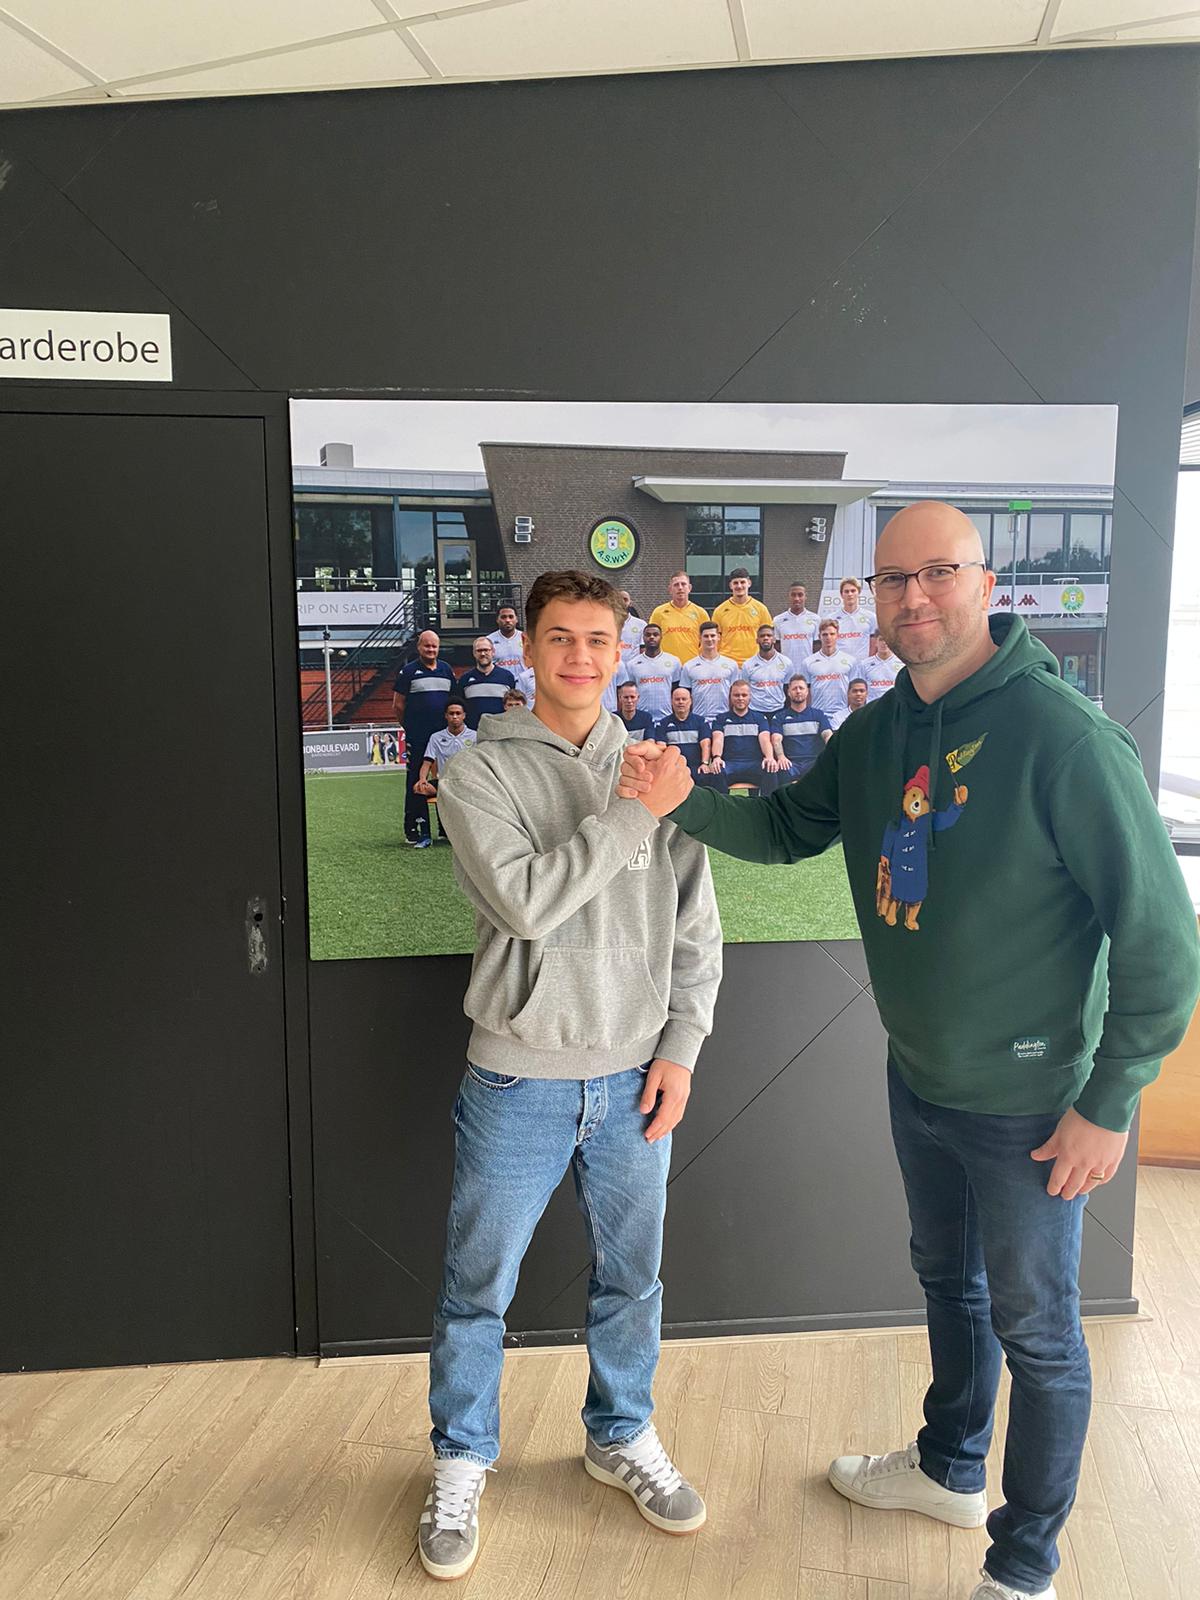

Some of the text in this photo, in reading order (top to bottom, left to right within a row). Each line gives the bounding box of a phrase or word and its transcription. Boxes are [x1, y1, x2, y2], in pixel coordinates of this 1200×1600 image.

[0, 329, 159, 363] arderobe
[319, 604, 339, 614] ON
[342, 604, 387, 614] SAFETY
